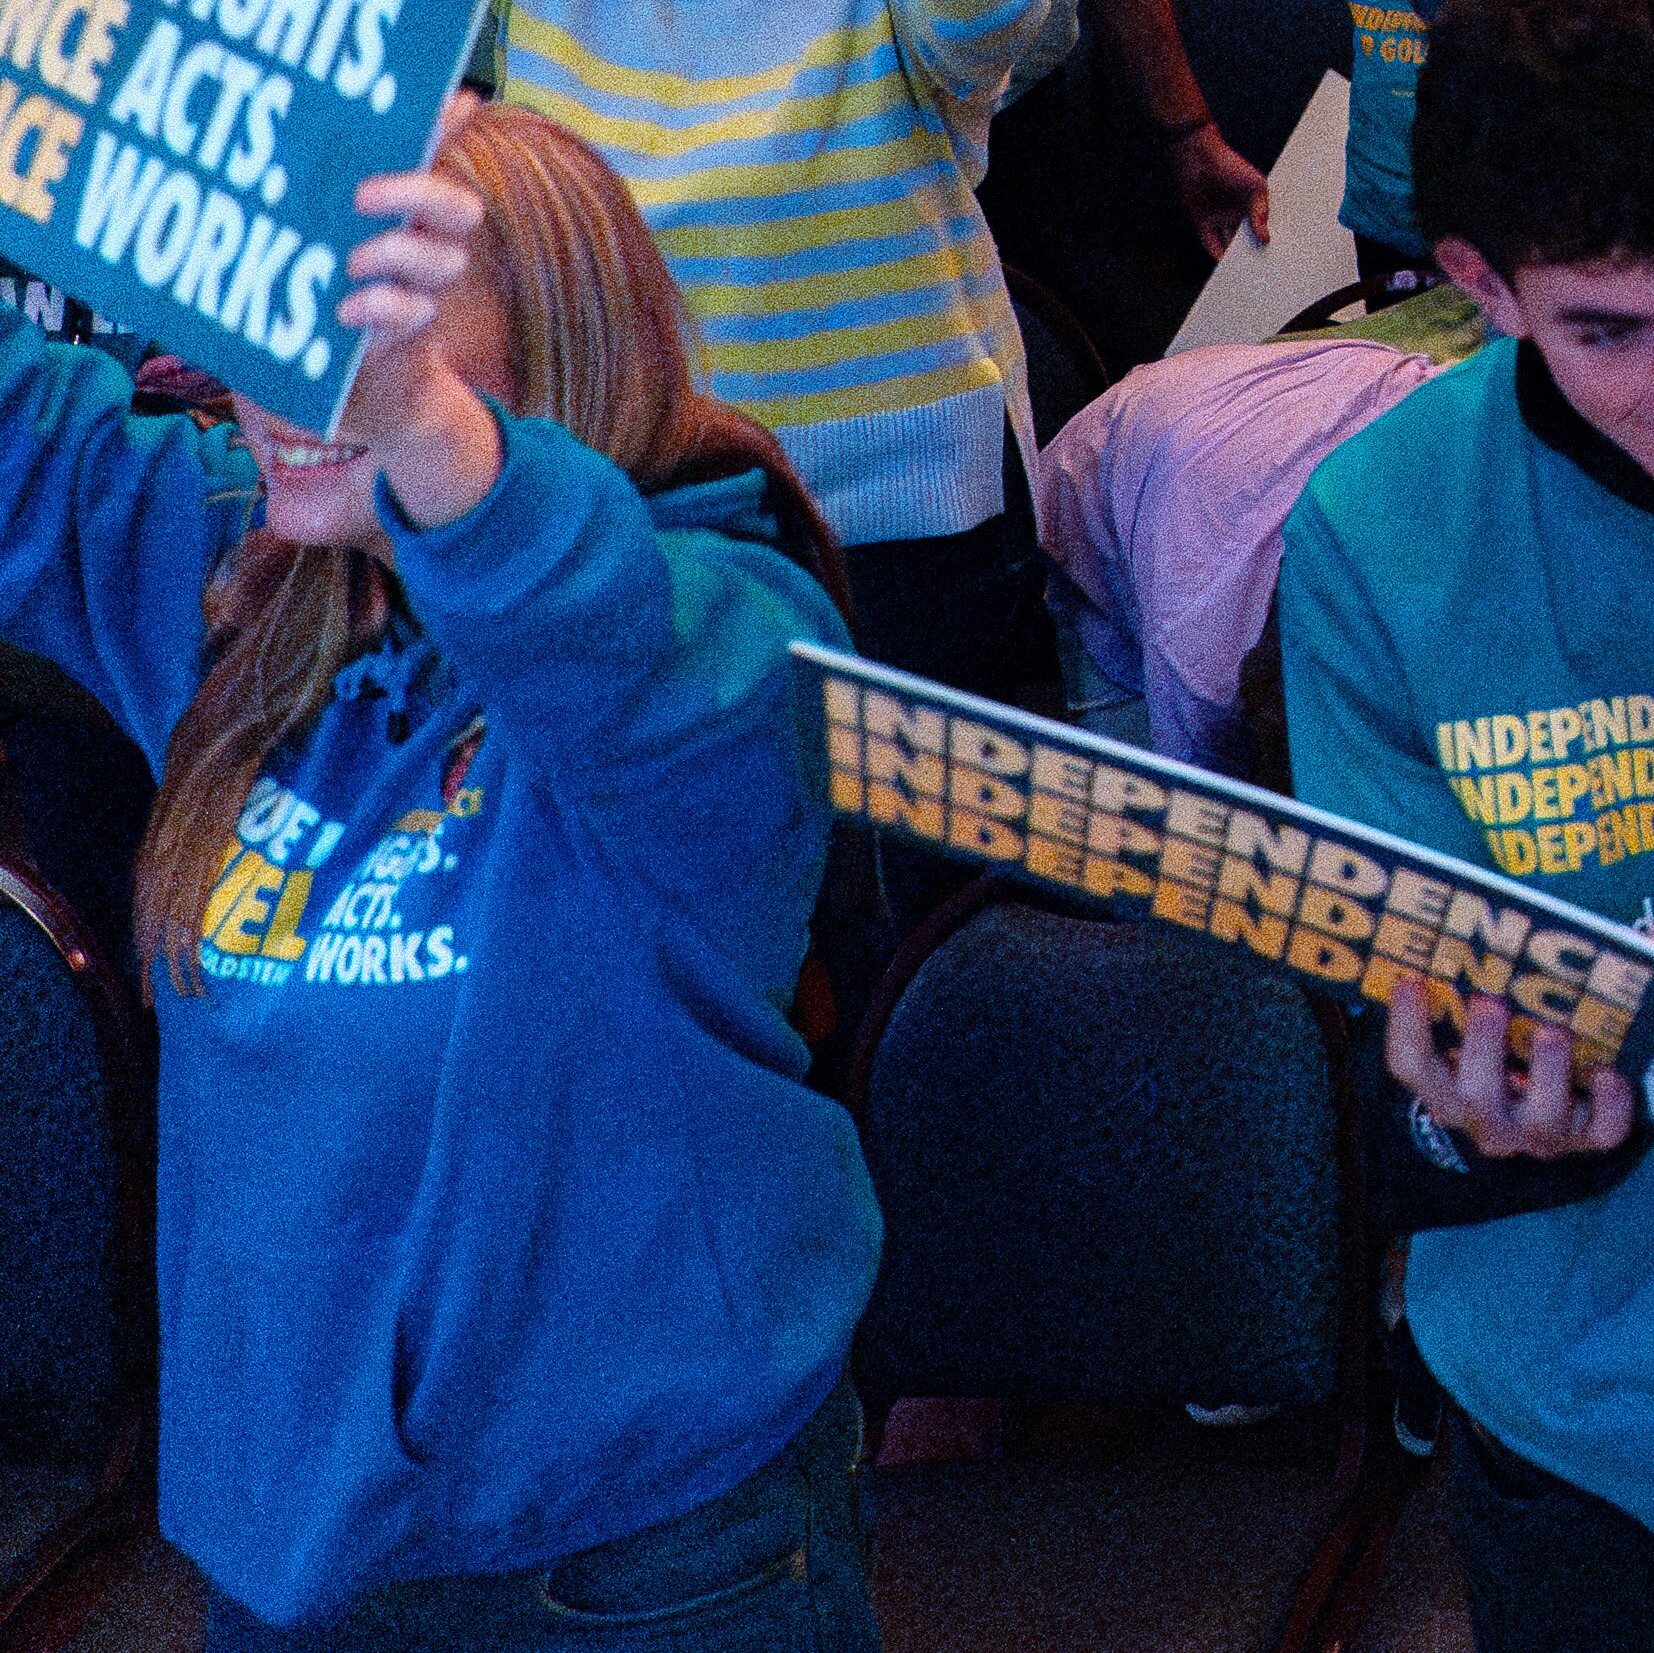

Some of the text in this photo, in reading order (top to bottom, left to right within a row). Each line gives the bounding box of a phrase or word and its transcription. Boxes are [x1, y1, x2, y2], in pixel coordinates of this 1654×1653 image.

[109, 18, 293, 205] ACTS.
[74, 130, 338, 382] WORKS.
[306, 926, 468, 984] WORKS.
[823, 676, 1654, 1004] INDEPENDENCE
[825, 725, 1641, 1048] INDEPENDENCE
